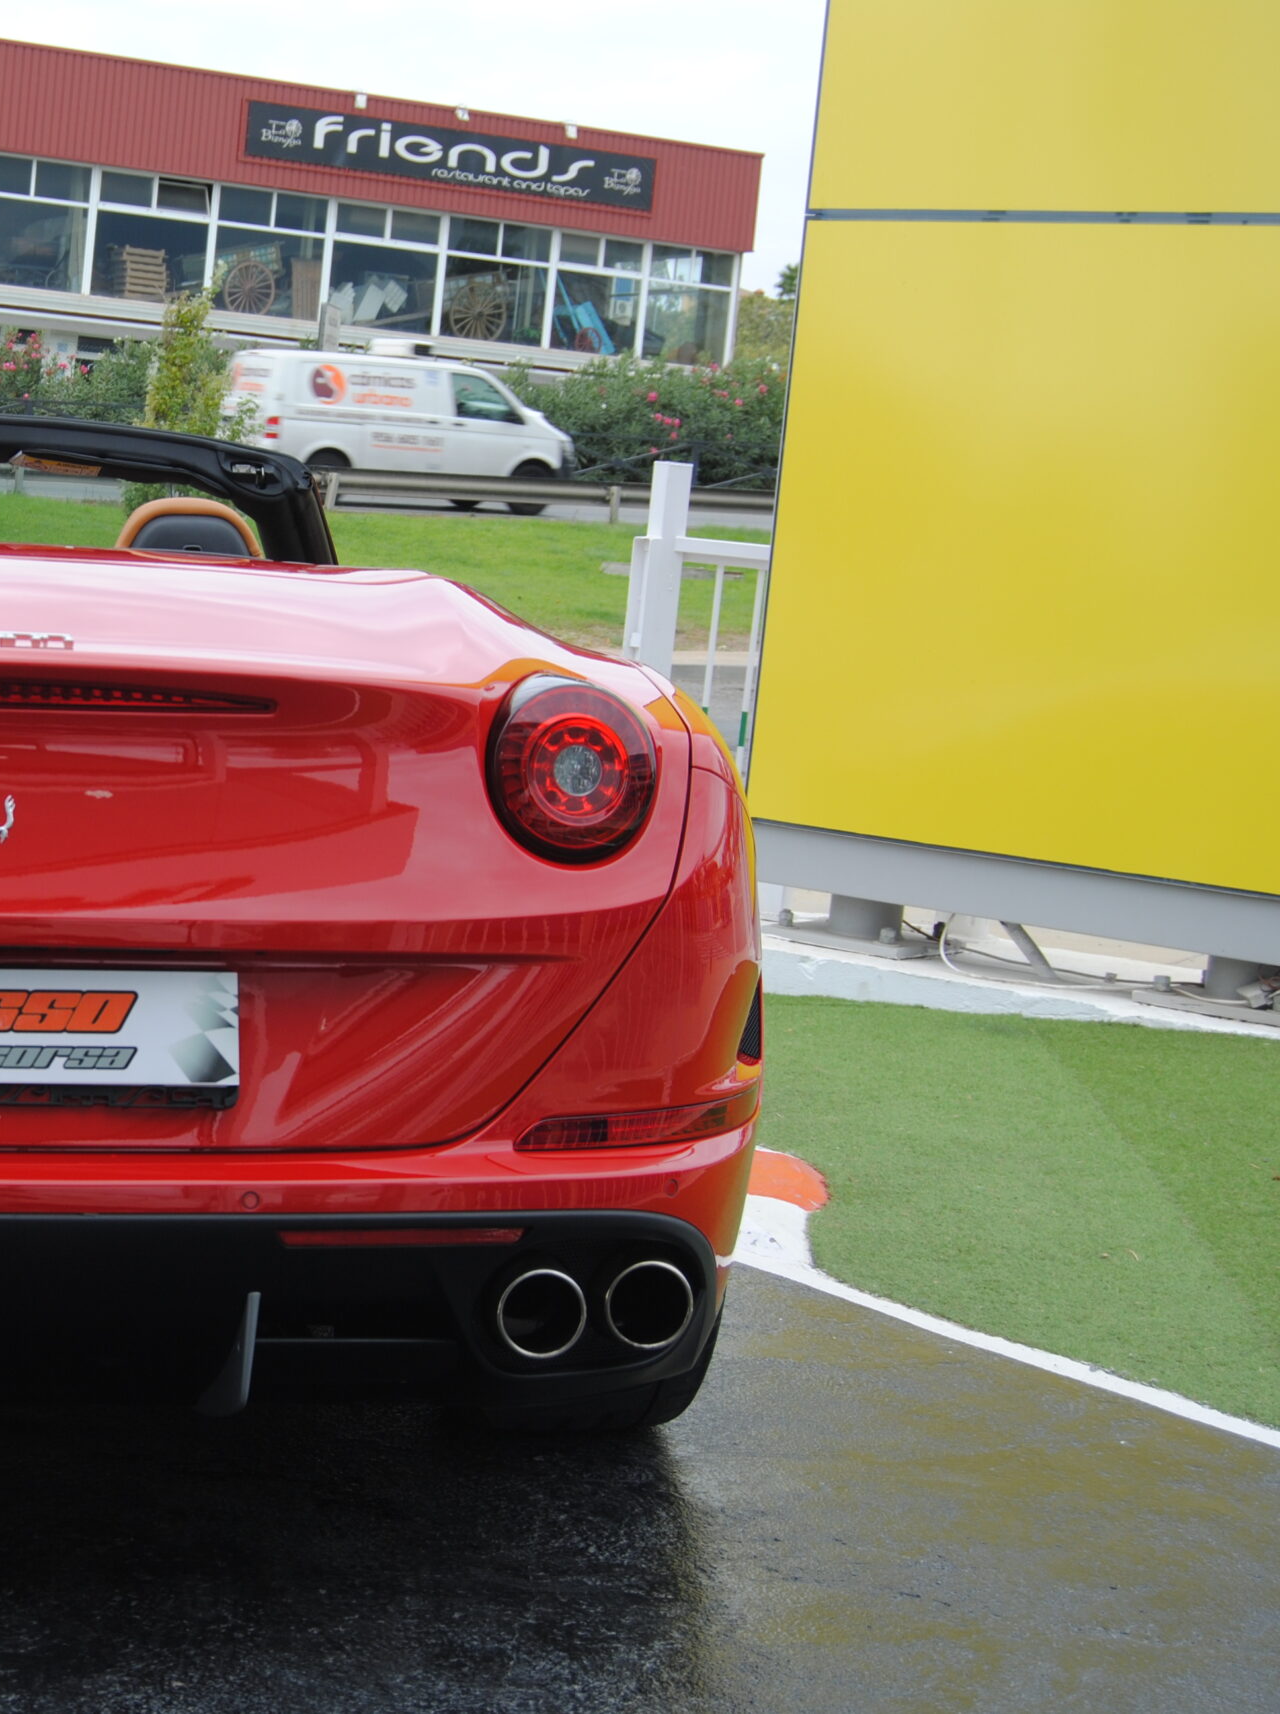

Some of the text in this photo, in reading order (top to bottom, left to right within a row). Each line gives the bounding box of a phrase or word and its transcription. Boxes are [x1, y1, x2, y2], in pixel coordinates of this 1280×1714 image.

[313, 115, 595, 183] friends
[431, 167, 591, 198] restaurant and tapas
